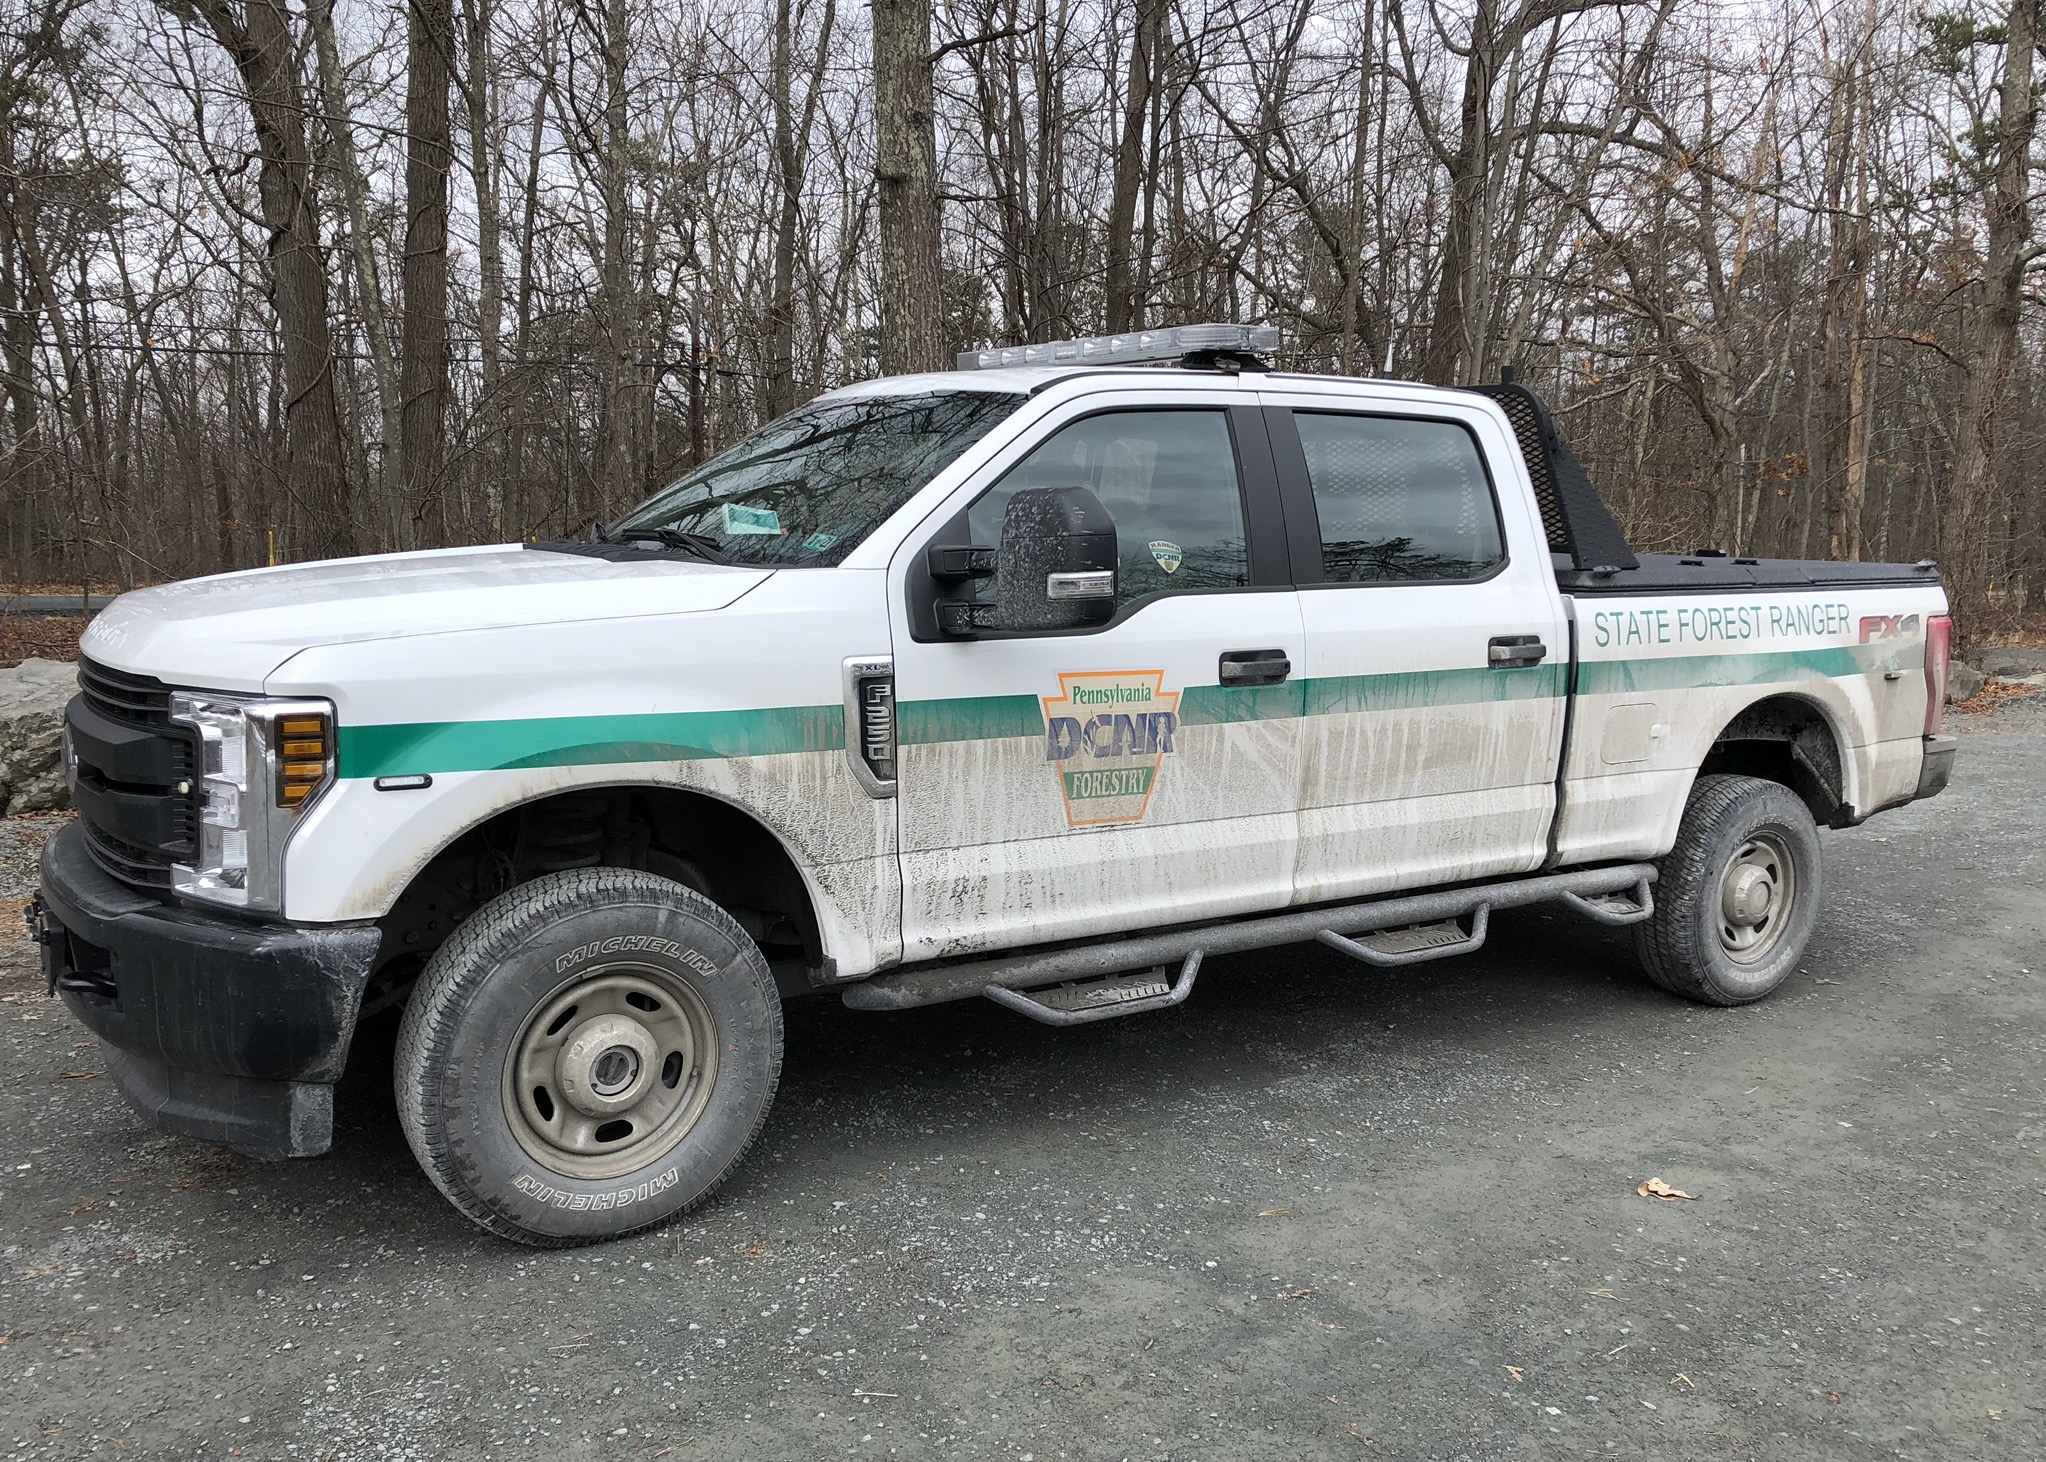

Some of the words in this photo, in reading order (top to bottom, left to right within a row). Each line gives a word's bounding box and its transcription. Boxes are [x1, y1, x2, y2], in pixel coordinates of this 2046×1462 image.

[1155, 553, 1180, 562] DCNR
[1594, 608, 1671, 648] STATE
[1676, 606, 1762, 643] FOREST
[1770, 603, 1851, 637] RANGER
[1859, 613, 1920, 645] FX4
[1072, 683, 1152, 709] Pennsylvania
[1046, 711, 1177, 761] DCNR
[1072, 768, 1147, 798] FORESTRY
[555, 935, 718, 977] MICHELIN
[514, 1167, 679, 1211] MICHELIN
